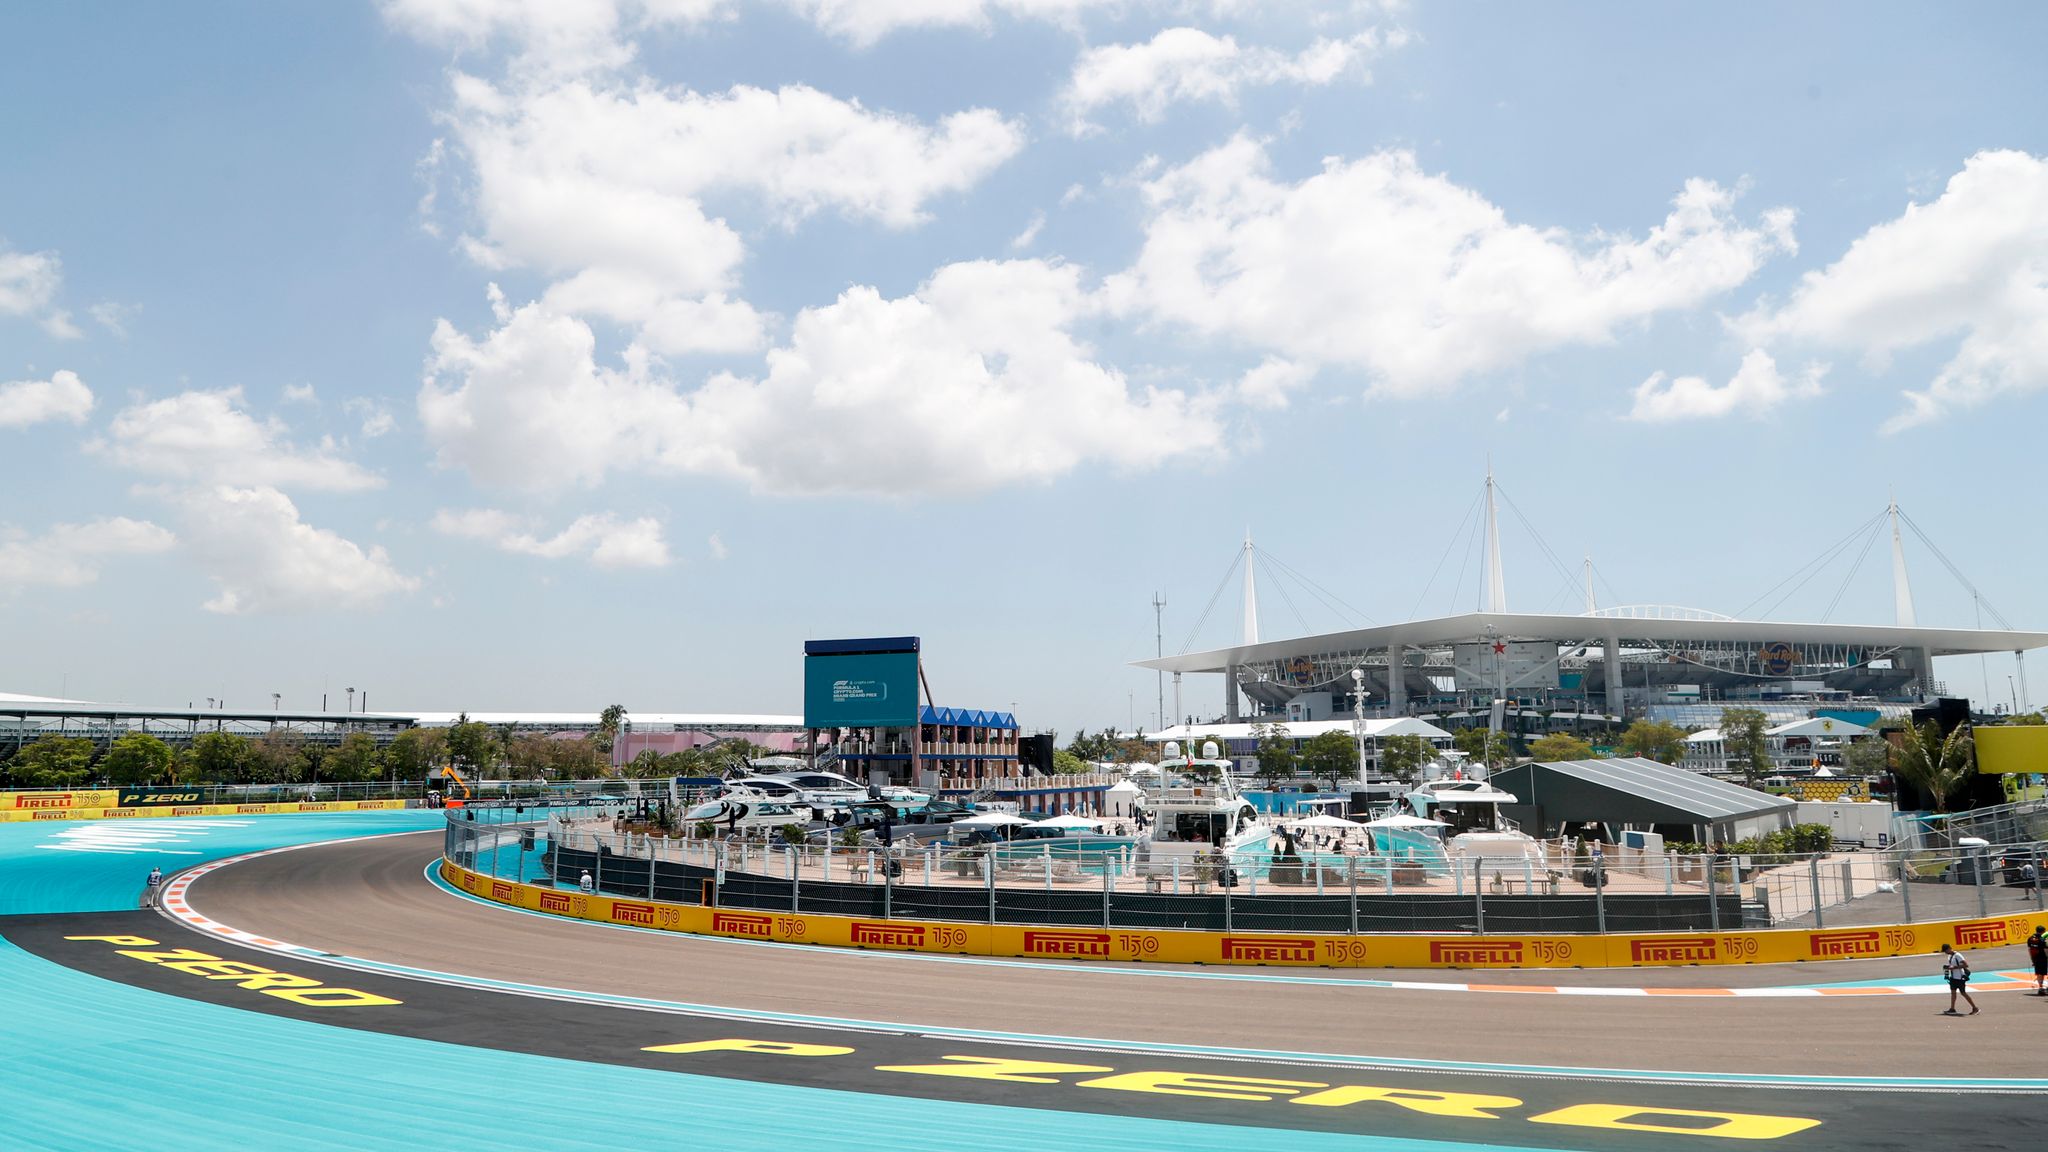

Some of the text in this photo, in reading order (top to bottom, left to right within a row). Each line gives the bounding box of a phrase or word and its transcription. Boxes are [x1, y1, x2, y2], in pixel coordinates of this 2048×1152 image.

[16, 793, 101, 808] PIRELLI 150
[123, 793, 199, 803] P ZERO
[32, 811, 67, 820] PIRELLI
[103, 809, 136, 817] PIRELLI
[492, 882, 513, 901] PIRELLI
[540, 892, 570, 912] PIRELLI
[612, 902, 680, 926] PIRELLI 150
[713, 913, 807, 938] PIRELLI 150
[851, 922, 967, 948] PIRELLI 150
[1024, 931, 1160, 957] PIRELLI 150
[1810, 930, 1916, 956] PIRELLI 150
[1954, 918, 2030, 945] PIRELLI 150
[1221, 938, 1367, 963] PIRELLI 150
[1430, 941, 1573, 964] PIRELLI 150
[1631, 937, 1759, 962] PIRELLI 150
[64, 935, 404, 1007] P ZERO
[639, 1038, 1823, 1140] P ZERO
